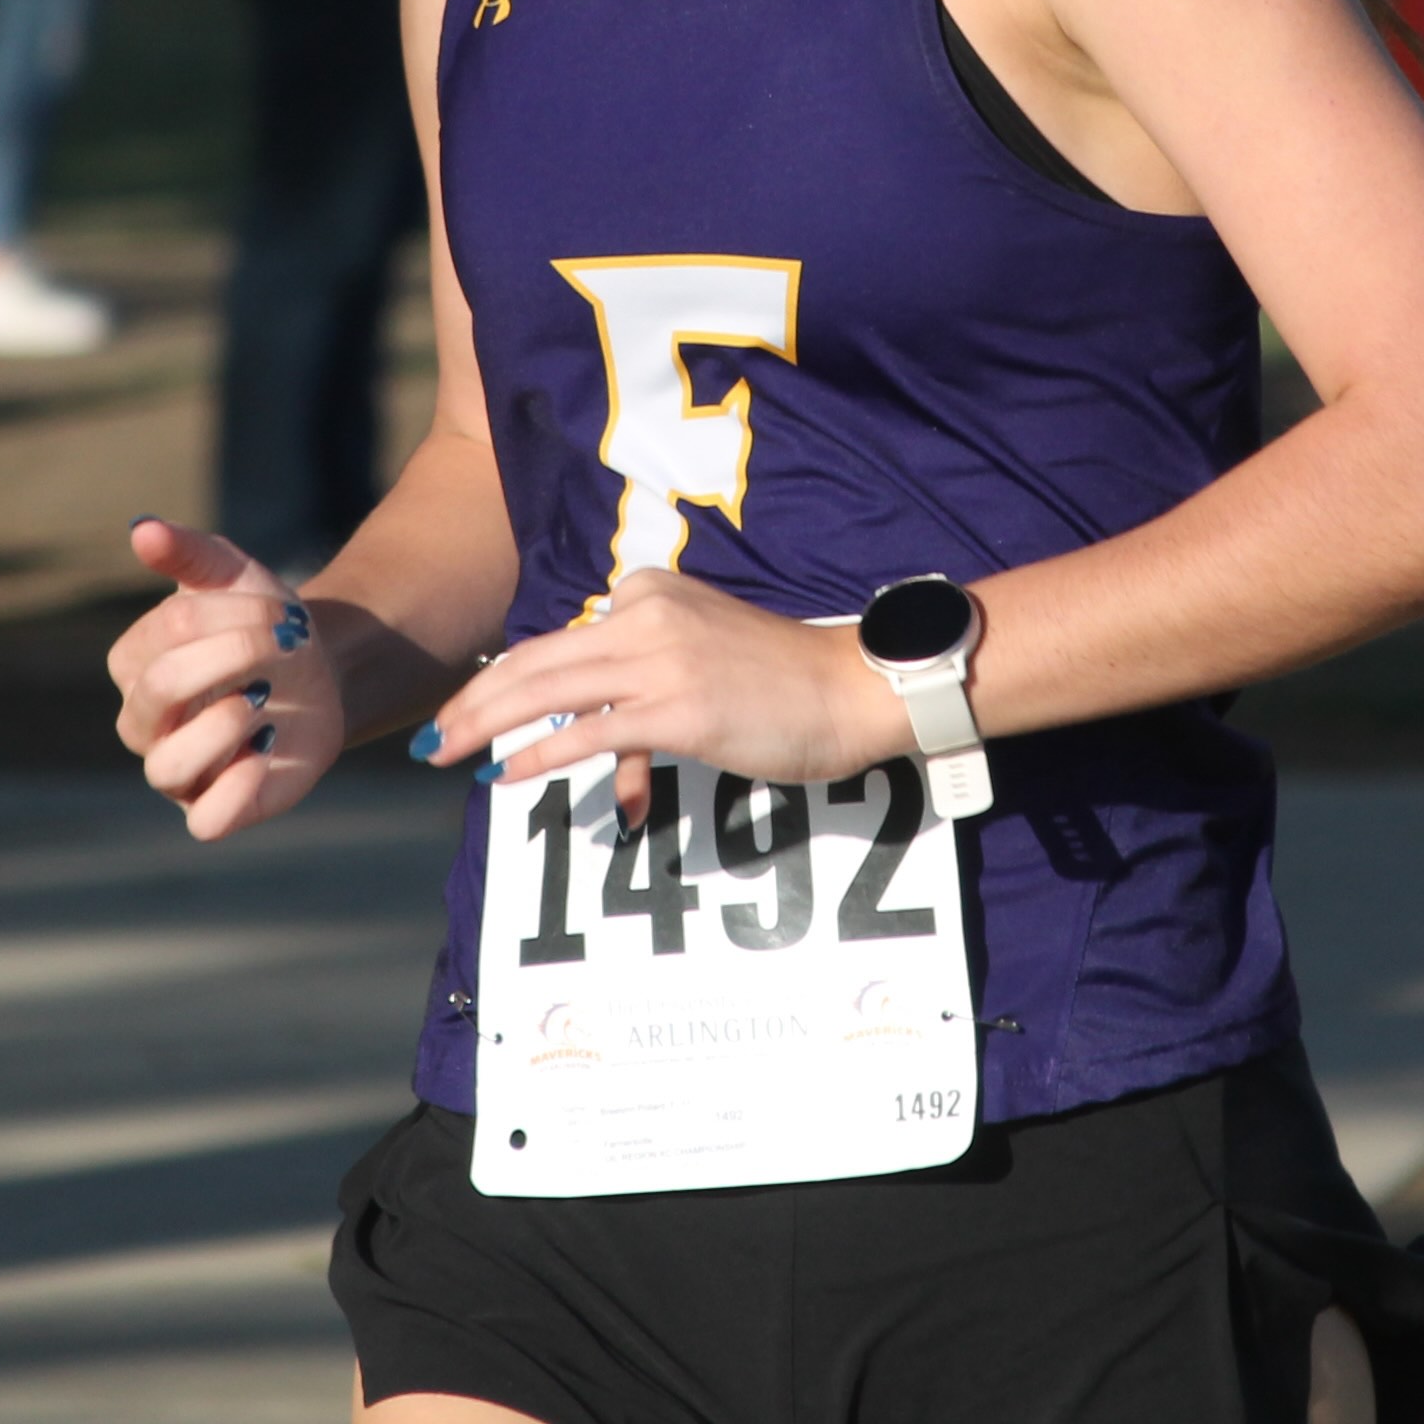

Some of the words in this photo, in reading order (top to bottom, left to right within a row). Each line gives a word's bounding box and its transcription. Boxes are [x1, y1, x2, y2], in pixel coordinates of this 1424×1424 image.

[550, 253, 803, 632] F
[518, 754, 938, 968] 1492
[627, 1013, 809, 1050] ARLINGTON
[894, 1089, 962, 1122] 1492
